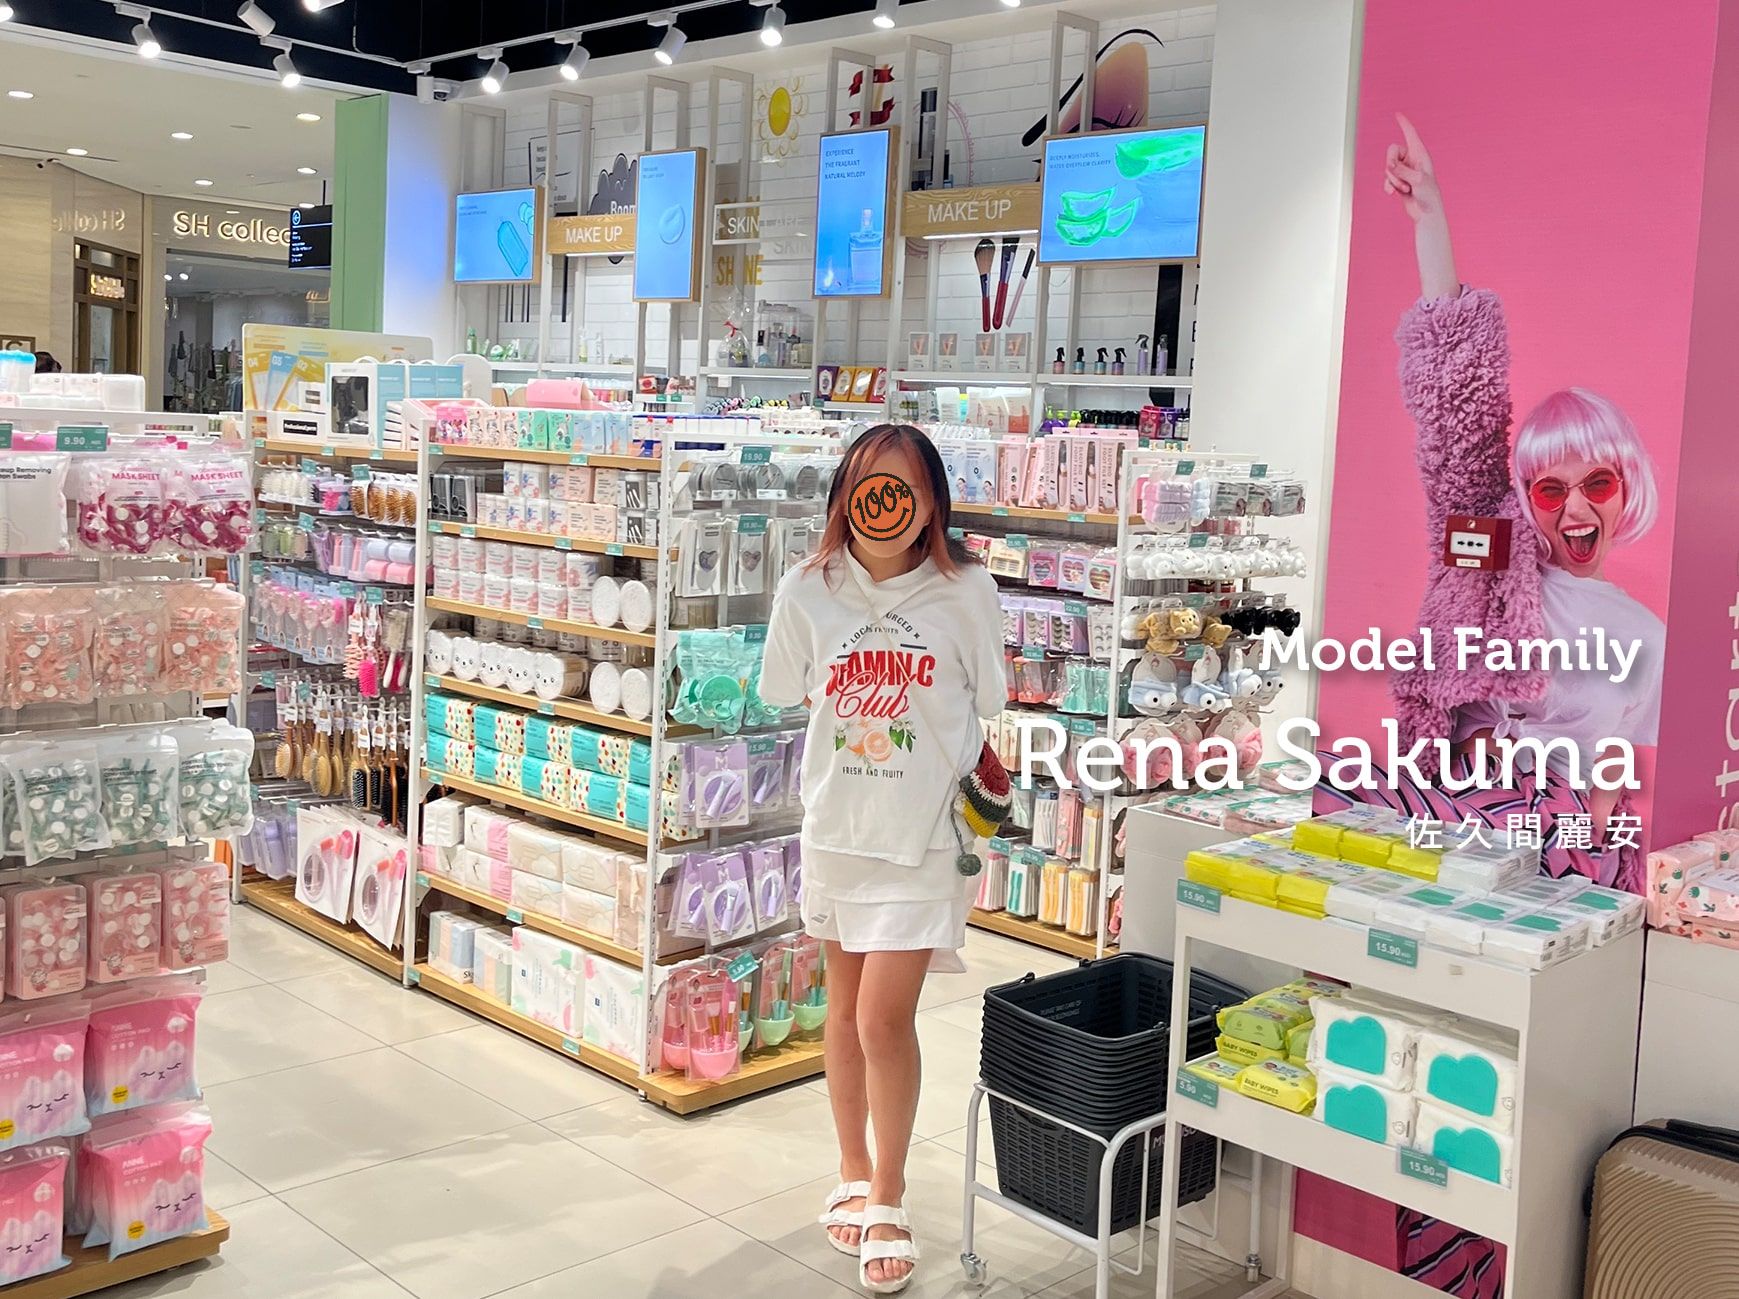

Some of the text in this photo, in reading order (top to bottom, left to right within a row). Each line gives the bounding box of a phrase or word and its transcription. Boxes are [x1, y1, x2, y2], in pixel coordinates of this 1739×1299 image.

[928, 199, 1011, 223] MAKE UP
[173, 210, 210, 238] SH
[727, 215, 760, 234] SKIN
[566, 226, 623, 244] MAKE UP
[717, 254, 765, 286] SHNE
[64, 436, 86, 446] 9.90
[112, 473, 160, 481] MASK SHEET
[191, 471, 243, 482] MASK SHEET
[842, 766, 904, 779] FRESH AND FRUITY
[1376, 942, 1401, 956] 15.90
[1223, 1042, 1258, 1057] BABY WIPES
[1244, 1078, 1279, 1095] BABY WIPES
[1409, 1161, 1435, 1176] 15.90
